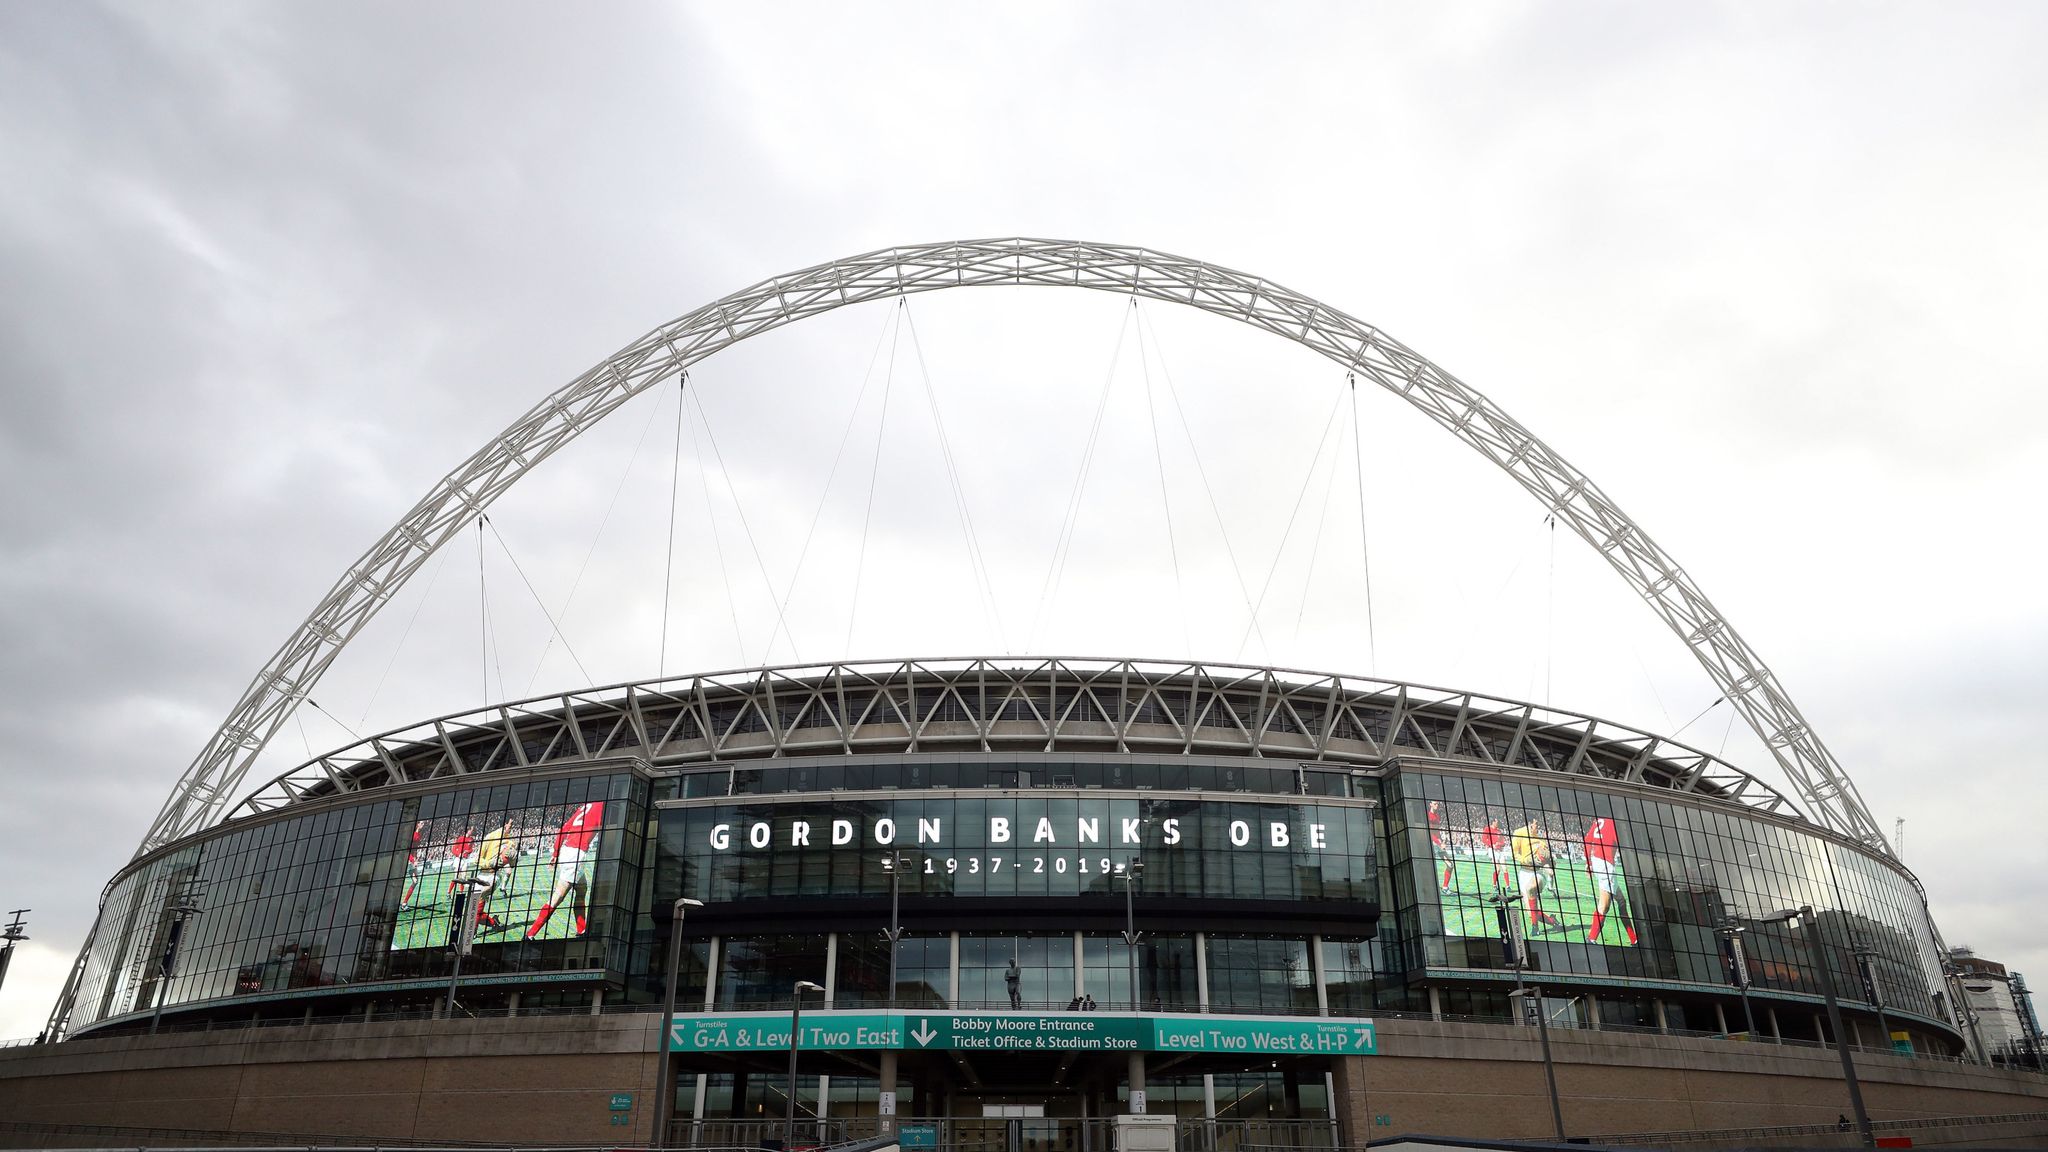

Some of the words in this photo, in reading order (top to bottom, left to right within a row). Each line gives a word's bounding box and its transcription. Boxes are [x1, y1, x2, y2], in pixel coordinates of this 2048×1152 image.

[572, 803, 593, 826] 2
[709, 818, 941, 849] GORDON
[990, 818, 1181, 844] BANKS
[1230, 821, 1327, 849] OBE
[1593, 818, 1604, 838] 2
[952, 1018, 992, 1032] Bobby
[996, 1018, 1036, 1030] Moore
[1040, 1018, 1095, 1031] Entrance
[694, 1029, 729, 1047] G-A
[736, 1029, 751, 1047] &
[811, 1028, 850, 1045] Two
[857, 1027, 899, 1045] East
[952, 1035, 990, 1048] Ticket
[994, 1035, 1032, 1048] Office
[1036, 1036, 1046, 1048] &
[1049, 1036, 1101, 1048] Stadium
[1105, 1036, 1138, 1048] Store
[1159, 1029, 1204, 1048] Level
[1209, 1031, 1247, 1049] Two
[1251, 1032, 1296, 1050] West
[1300, 1033, 1314, 1050] &
[1317, 1034, 1348, 1051] H-P
